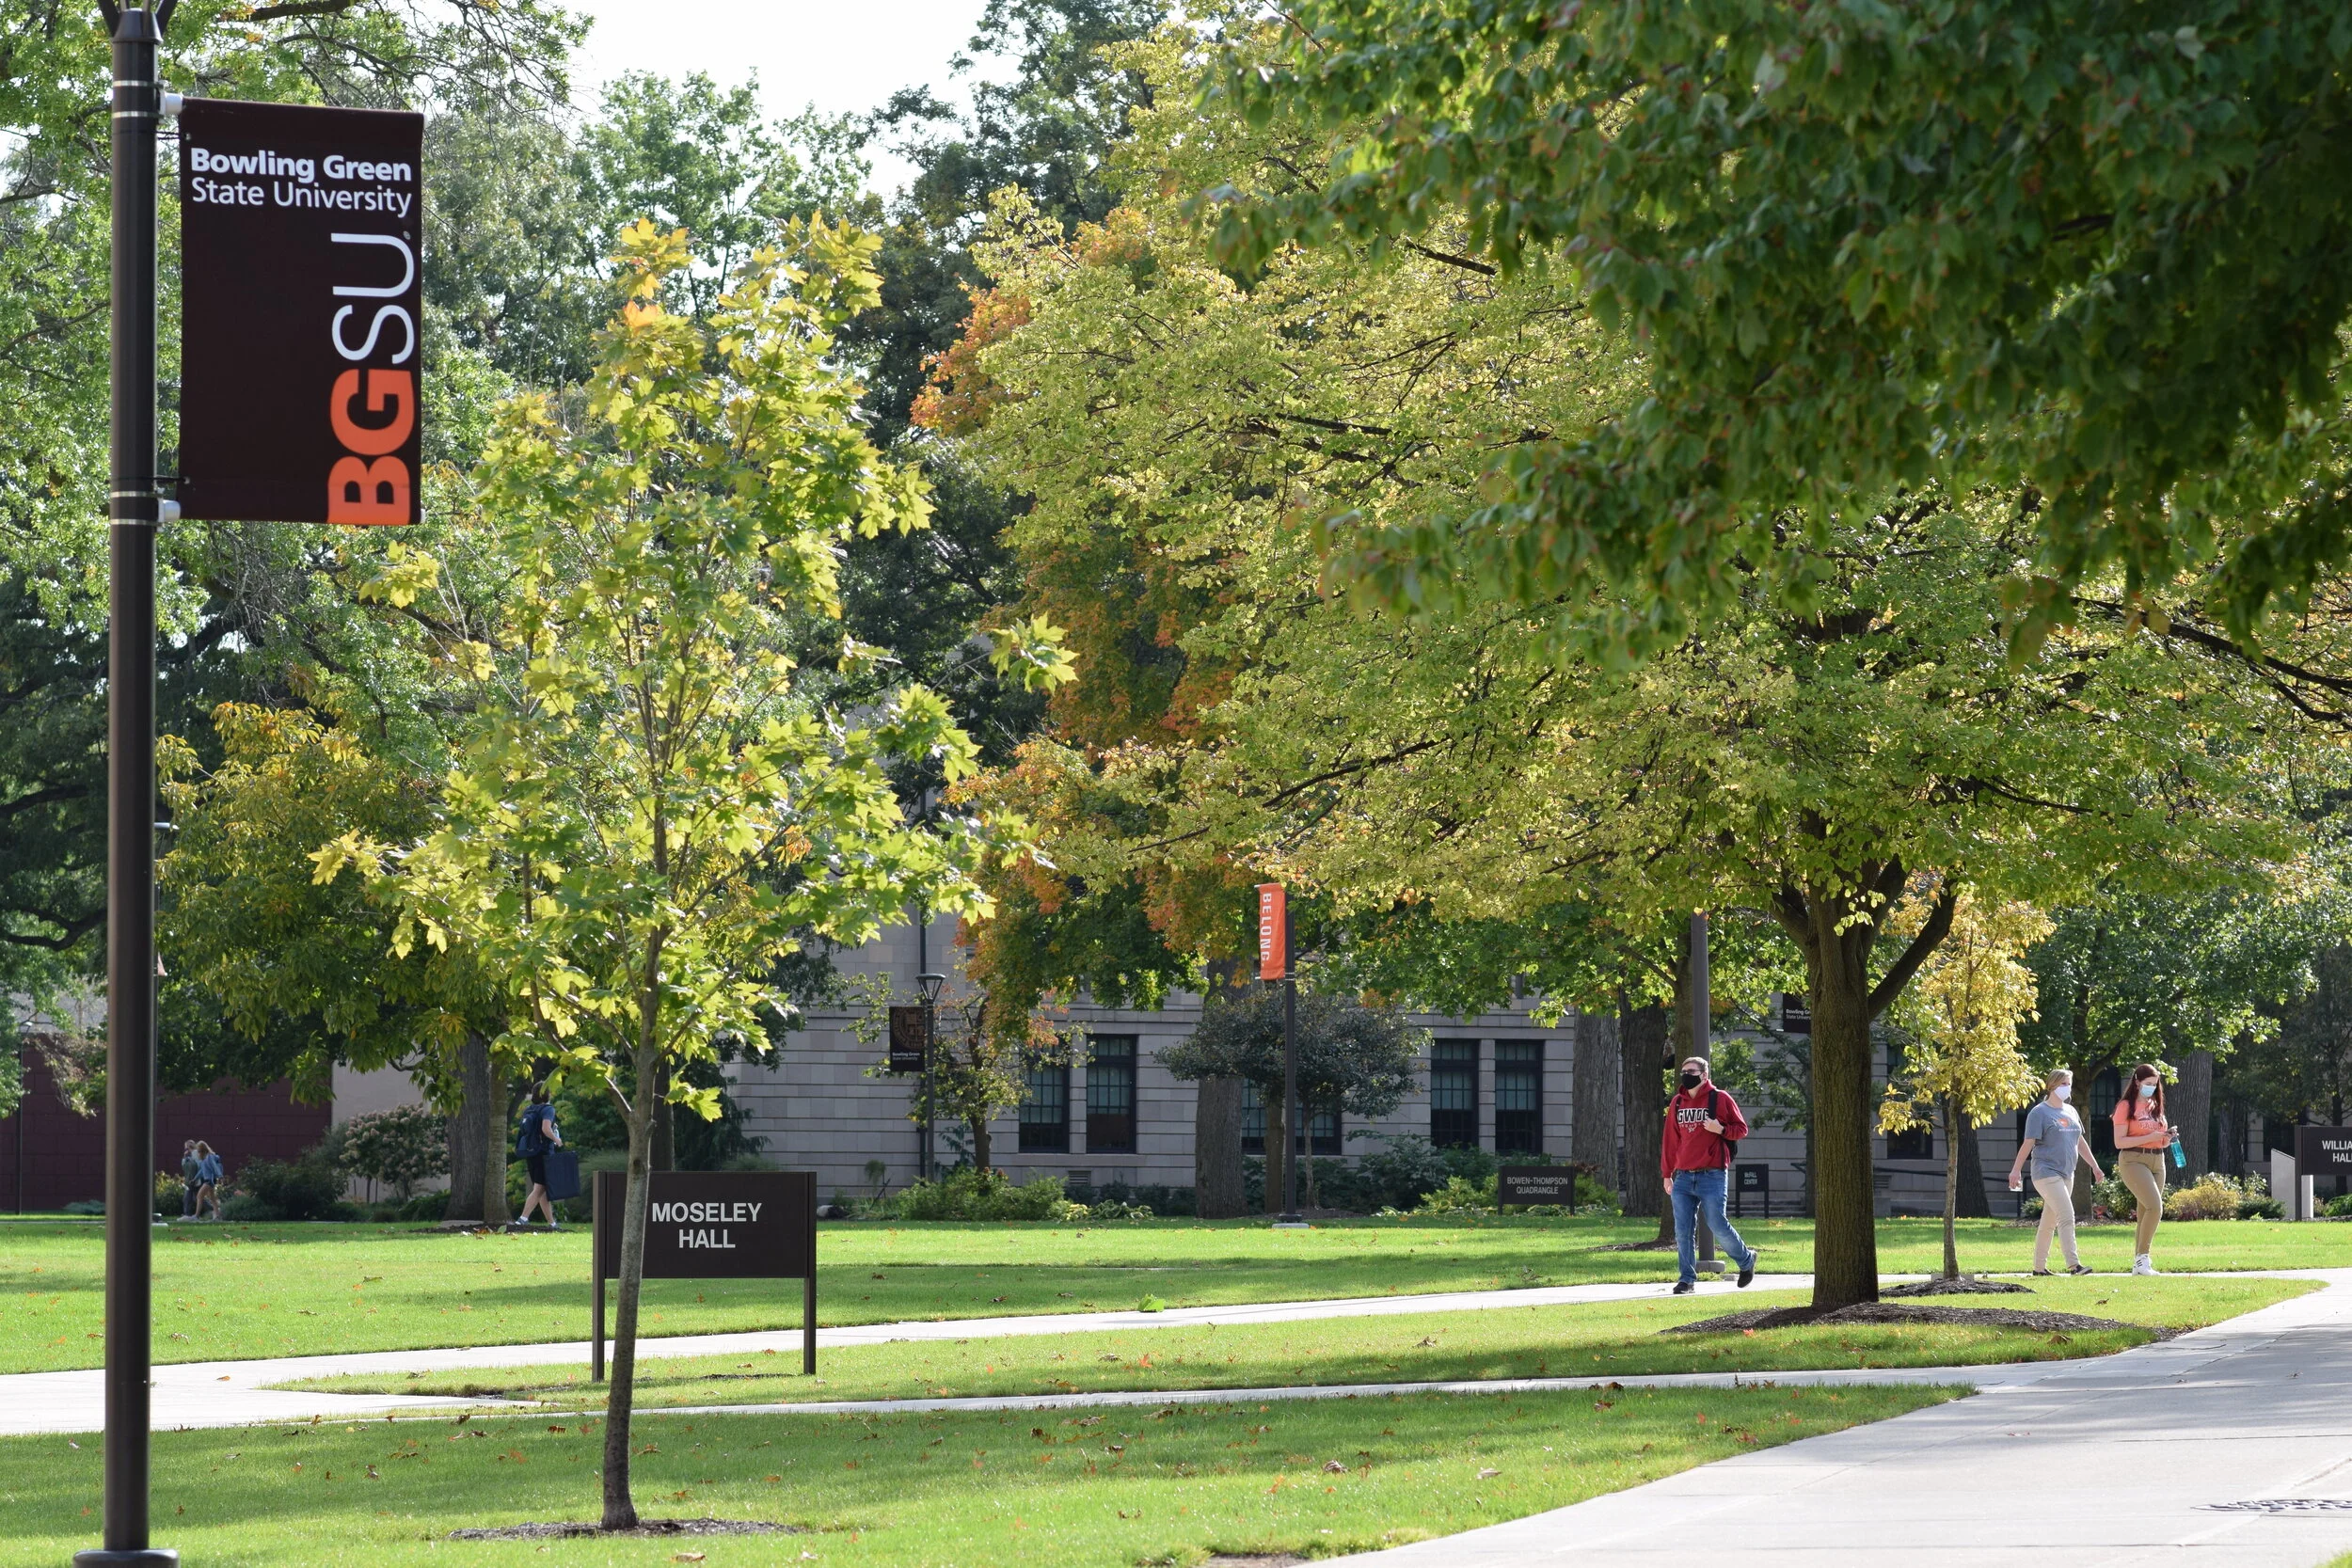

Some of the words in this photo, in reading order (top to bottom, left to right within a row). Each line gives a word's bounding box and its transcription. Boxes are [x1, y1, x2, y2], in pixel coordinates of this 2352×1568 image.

[191, 148, 315, 183] Bowling
[323, 154, 411, 181] Green
[191, 177, 264, 206] State
[274, 182, 412, 218] University
[327, 232, 415, 525] BGSU
[2322, 1140, 2352, 1150] WILLIA
[2332, 1152, 2352, 1163] HAL
[1506, 1177, 1568, 1185] BOWEN-THOMPSON
[1516, 1186, 1559, 1195] QUADRANGLE
[652, 1202, 762, 1223] MOSELEY
[678, 1228, 736, 1249] HALL
